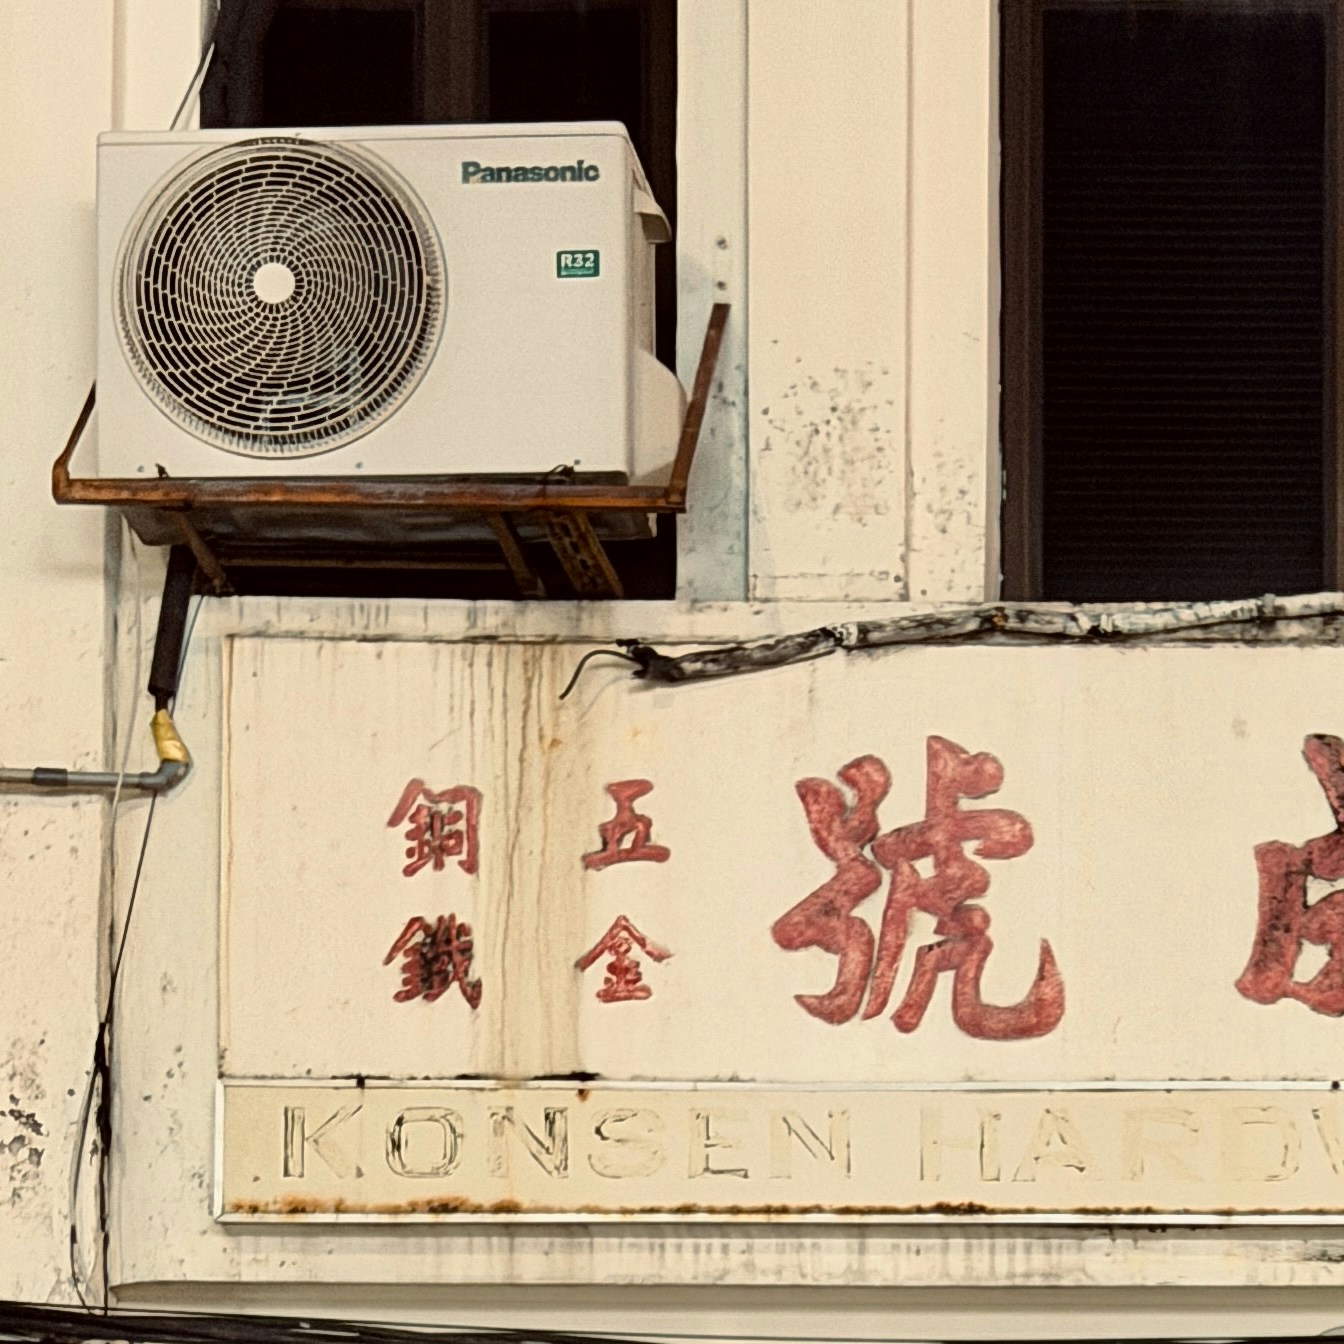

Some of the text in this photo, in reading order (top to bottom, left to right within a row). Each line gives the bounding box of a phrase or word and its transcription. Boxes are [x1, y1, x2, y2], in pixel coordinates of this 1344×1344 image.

[461, 160, 600, 184] Panasonic
[560, 253, 595, 268] R32
[576, 778, 672, 1004] 五金
[282, 1103, 852, 1181] KONSEN
